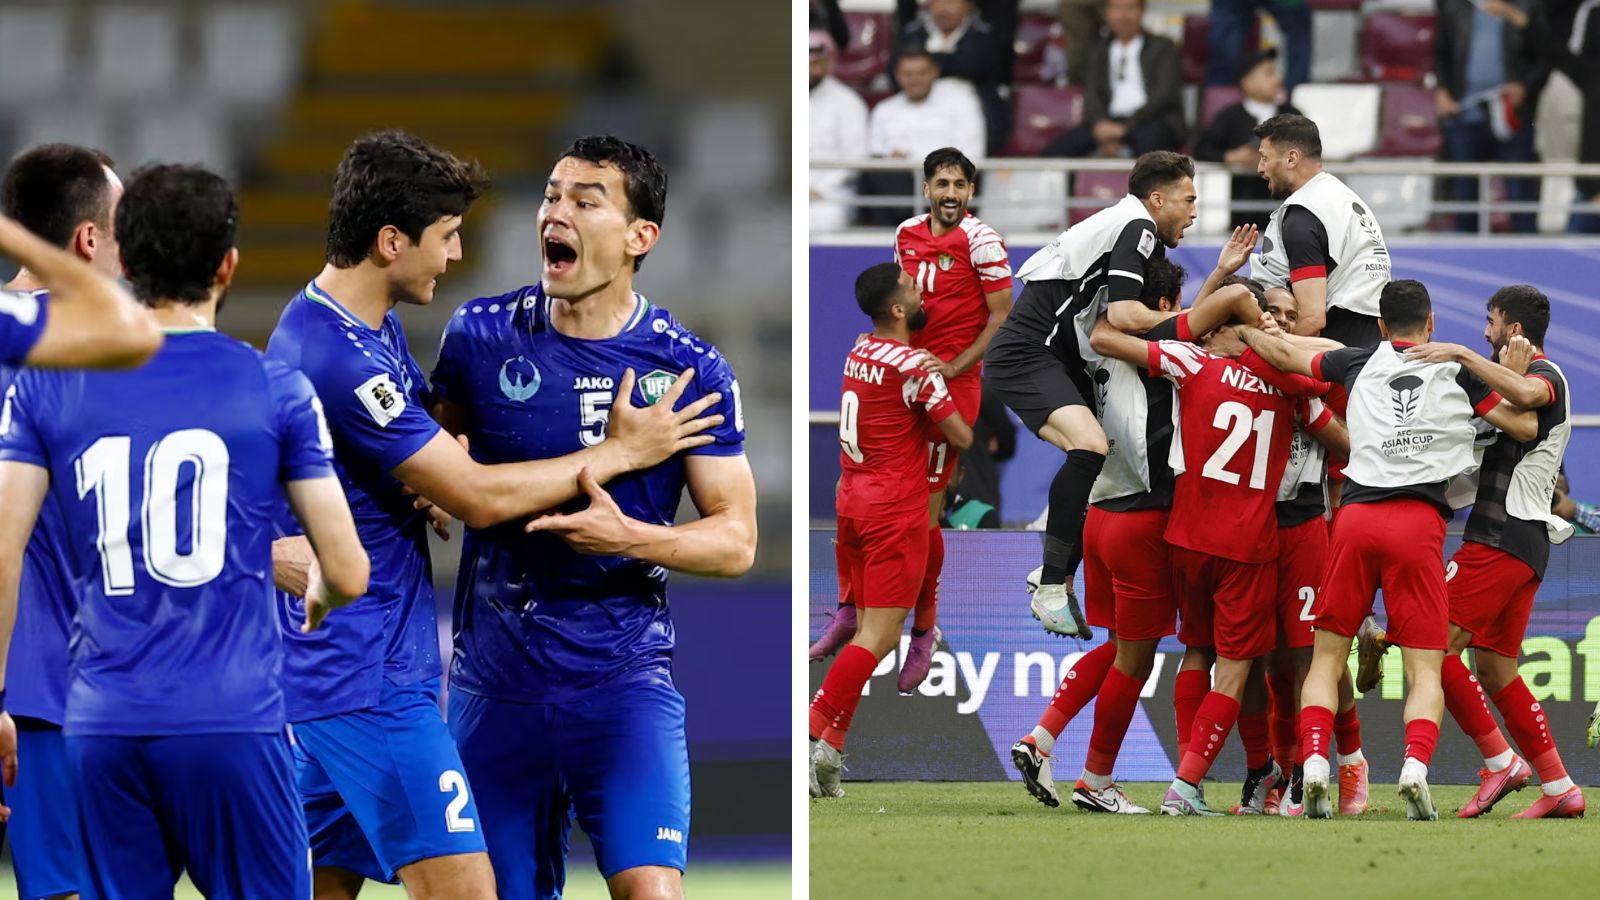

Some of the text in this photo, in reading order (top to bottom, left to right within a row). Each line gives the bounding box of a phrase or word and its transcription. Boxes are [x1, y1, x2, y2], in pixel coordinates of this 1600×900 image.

[916, 260, 937, 293] 11
[573, 376, 614, 390] JAKO
[578, 391, 613, 448] 5
[839, 390, 864, 464] 9
[1397, 429, 1412, 437] AFC
[1201, 400, 1275, 490] 21
[1381, 434, 1433, 449] ASIAN CUP
[1384, 446, 1409, 457] QATAR
[74, 428, 230, 597] 10
[1298, 586, 1321, 621] 2
[439, 769, 475, 832] 2
[656, 827, 683, 844] JAKO
